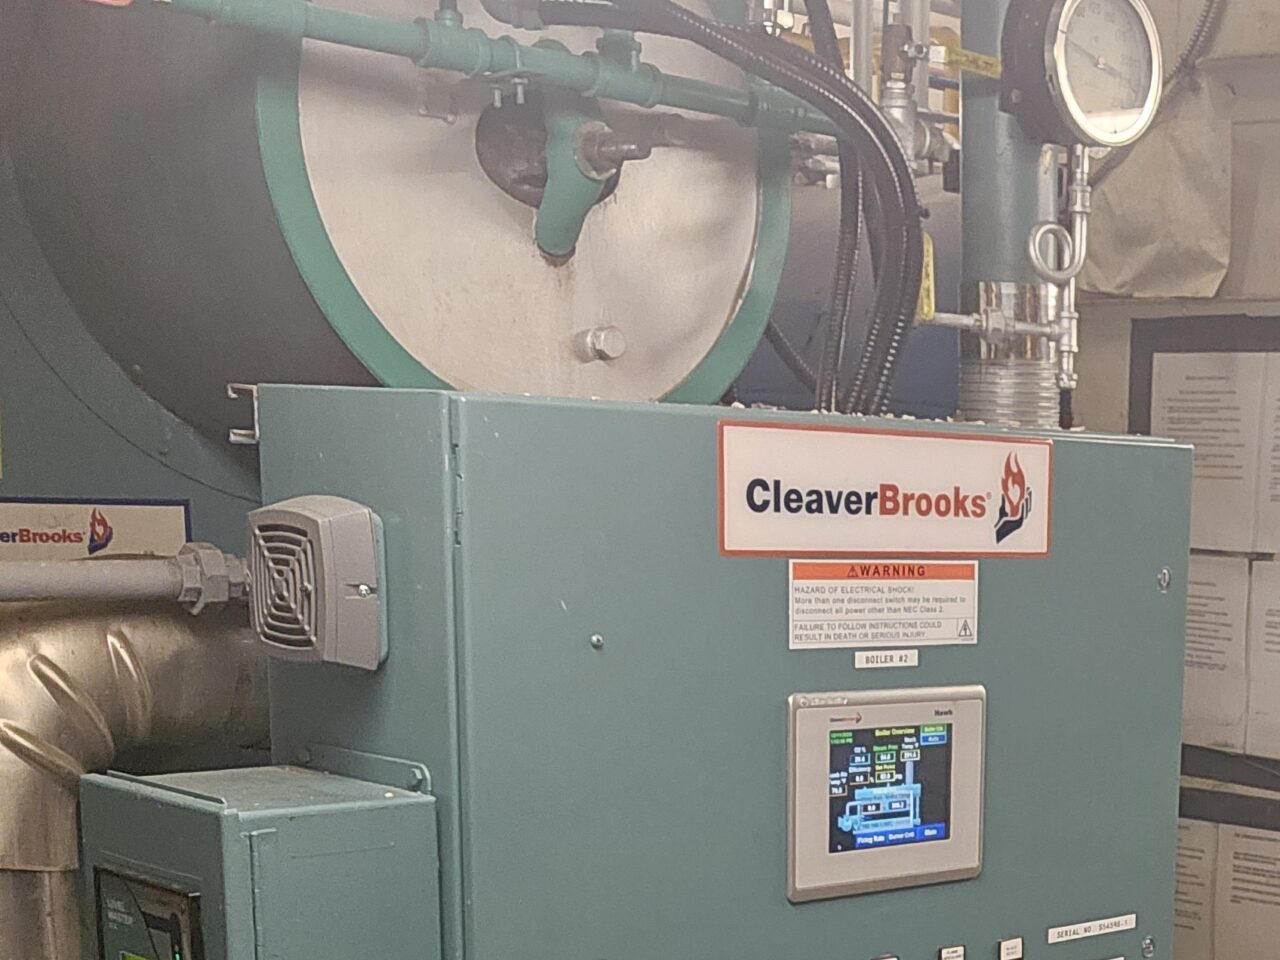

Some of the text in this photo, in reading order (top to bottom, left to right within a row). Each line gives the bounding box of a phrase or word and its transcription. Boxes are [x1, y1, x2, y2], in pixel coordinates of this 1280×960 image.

[746, 478, 987, 518] CleaverBrooks
[860, 565, 926, 577] WARNING
[795, 586, 825, 594] HAZARD
[828, 586, 838, 594] OF
[841, 586, 886, 594] ELECTRICAL
[887, 606, 901, 614] than
[838, 622, 866, 630] FOLLOW
[834, 632, 857, 640] DEATH
[865, 654, 908, 664] BOILER #2
[1056, 929, 1080, 938] SERIAL
